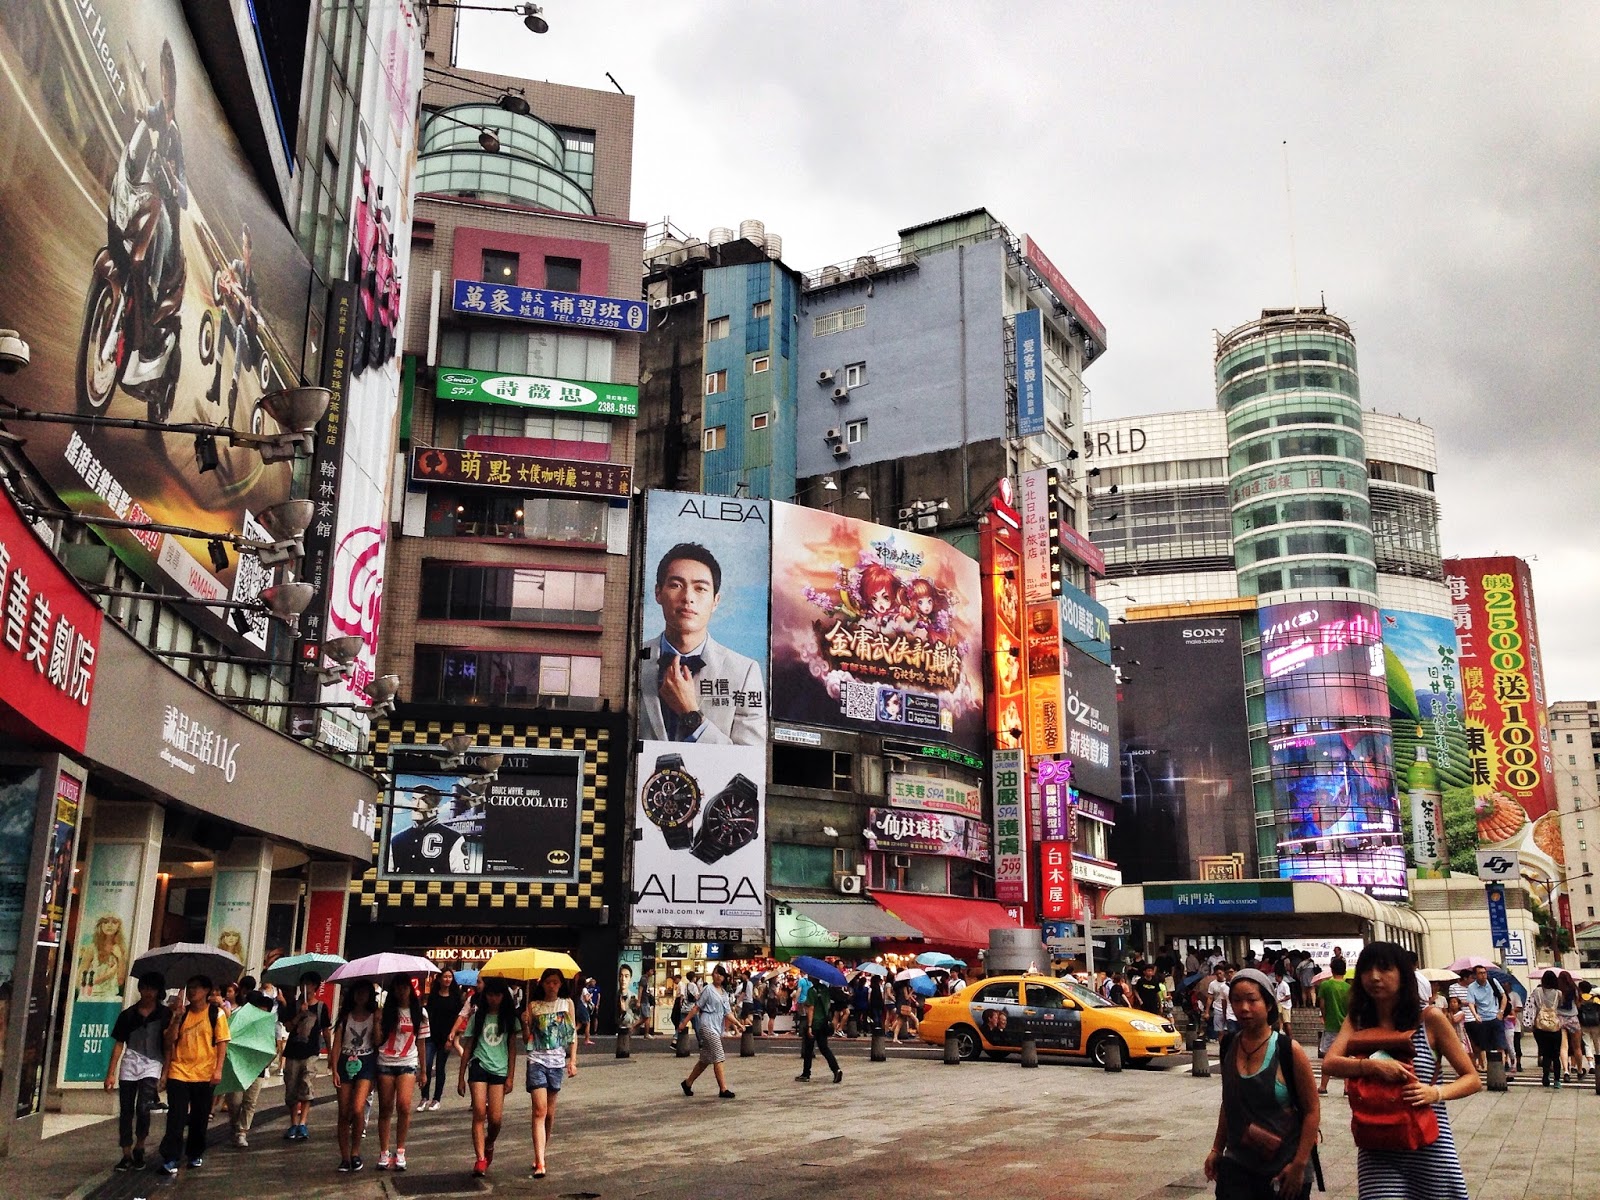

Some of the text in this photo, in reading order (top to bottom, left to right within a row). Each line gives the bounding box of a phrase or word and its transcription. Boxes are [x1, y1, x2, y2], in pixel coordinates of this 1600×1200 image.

[92, 15, 126, 96] Heart
[462, 285, 514, 313] 萬象
[551, 296, 624, 320] 補習班
[450, 387, 474, 396] SPA
[598, 401, 636, 415] 2388-8155
[460, 451, 512, 484] 萌點
[315, 460, 338, 538] 翰林茶館
[678, 498, 766, 525] ALBA
[188, 566, 218, 602] YAMAHA
[1182, 628, 1227, 638] SONY
[699, 678, 730, 696] 自信
[1464, 666, 1487, 711] 懷念
[732, 690, 763, 708] 有型
[491, 785, 507, 795] BRUCE
[895, 782, 926, 799] 玉芙蓉
[926, 787, 945, 799] SPA
[996, 770, 1019, 806] 油壓
[997, 806, 1018, 818] SPA
[421, 833, 444, 859] C
[1048, 847, 1065, 903] 白木屋
[637, 874, 763, 905] ALBA
[1178, 892, 1215, 905] 西門站
[635, 907, 705, 915] www.alba.com.tw
[79, 1023, 109, 1038] ANNA
[83, 1039, 102, 1054] SUI
